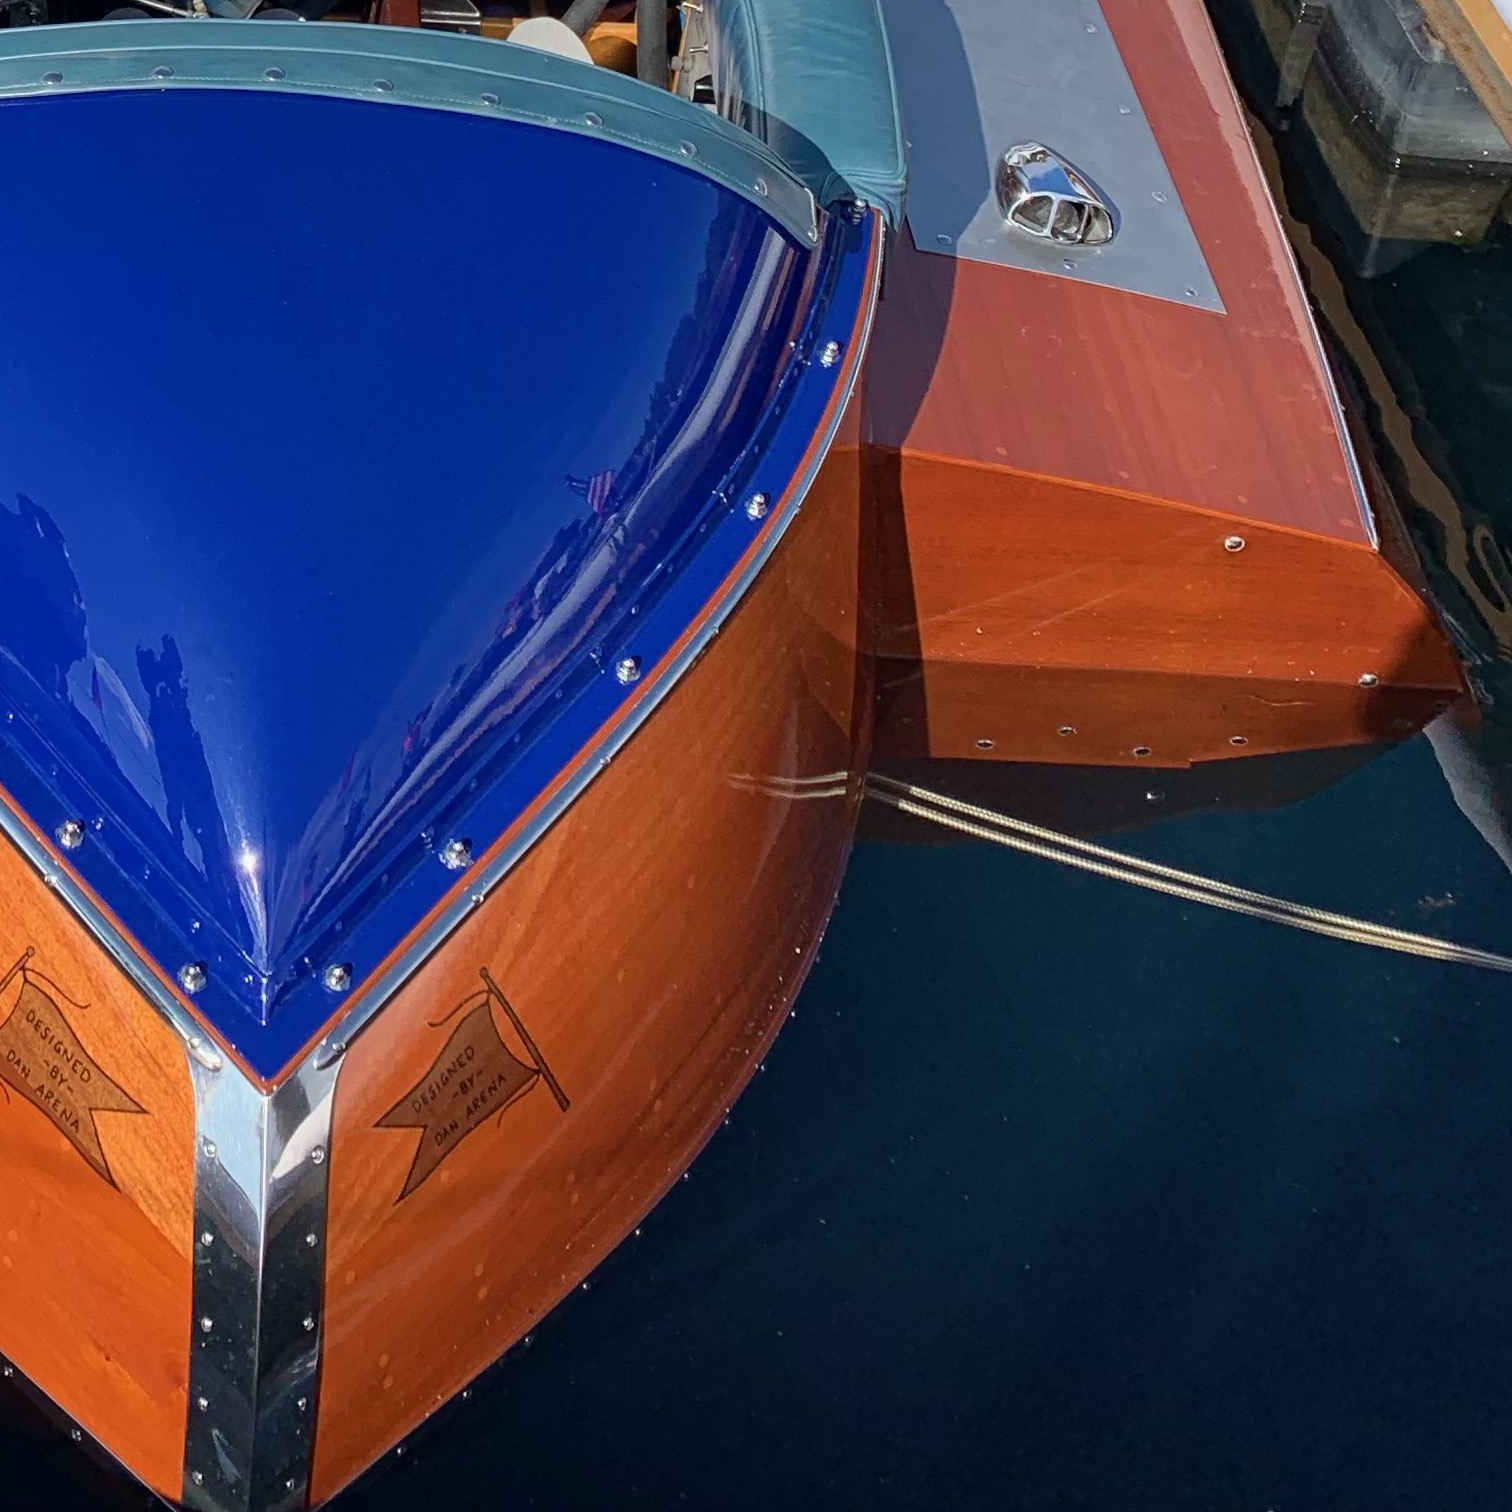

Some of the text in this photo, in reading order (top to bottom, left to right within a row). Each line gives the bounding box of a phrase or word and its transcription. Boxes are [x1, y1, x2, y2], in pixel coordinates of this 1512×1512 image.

[25, 1009, 92, 1084] DESIGNED
[411, 1045, 476, 1115] DESIGNED
[6, 1049, 81, 1134] DAN ARENA
[433, 1073, 508, 1148] DAN ARENA
